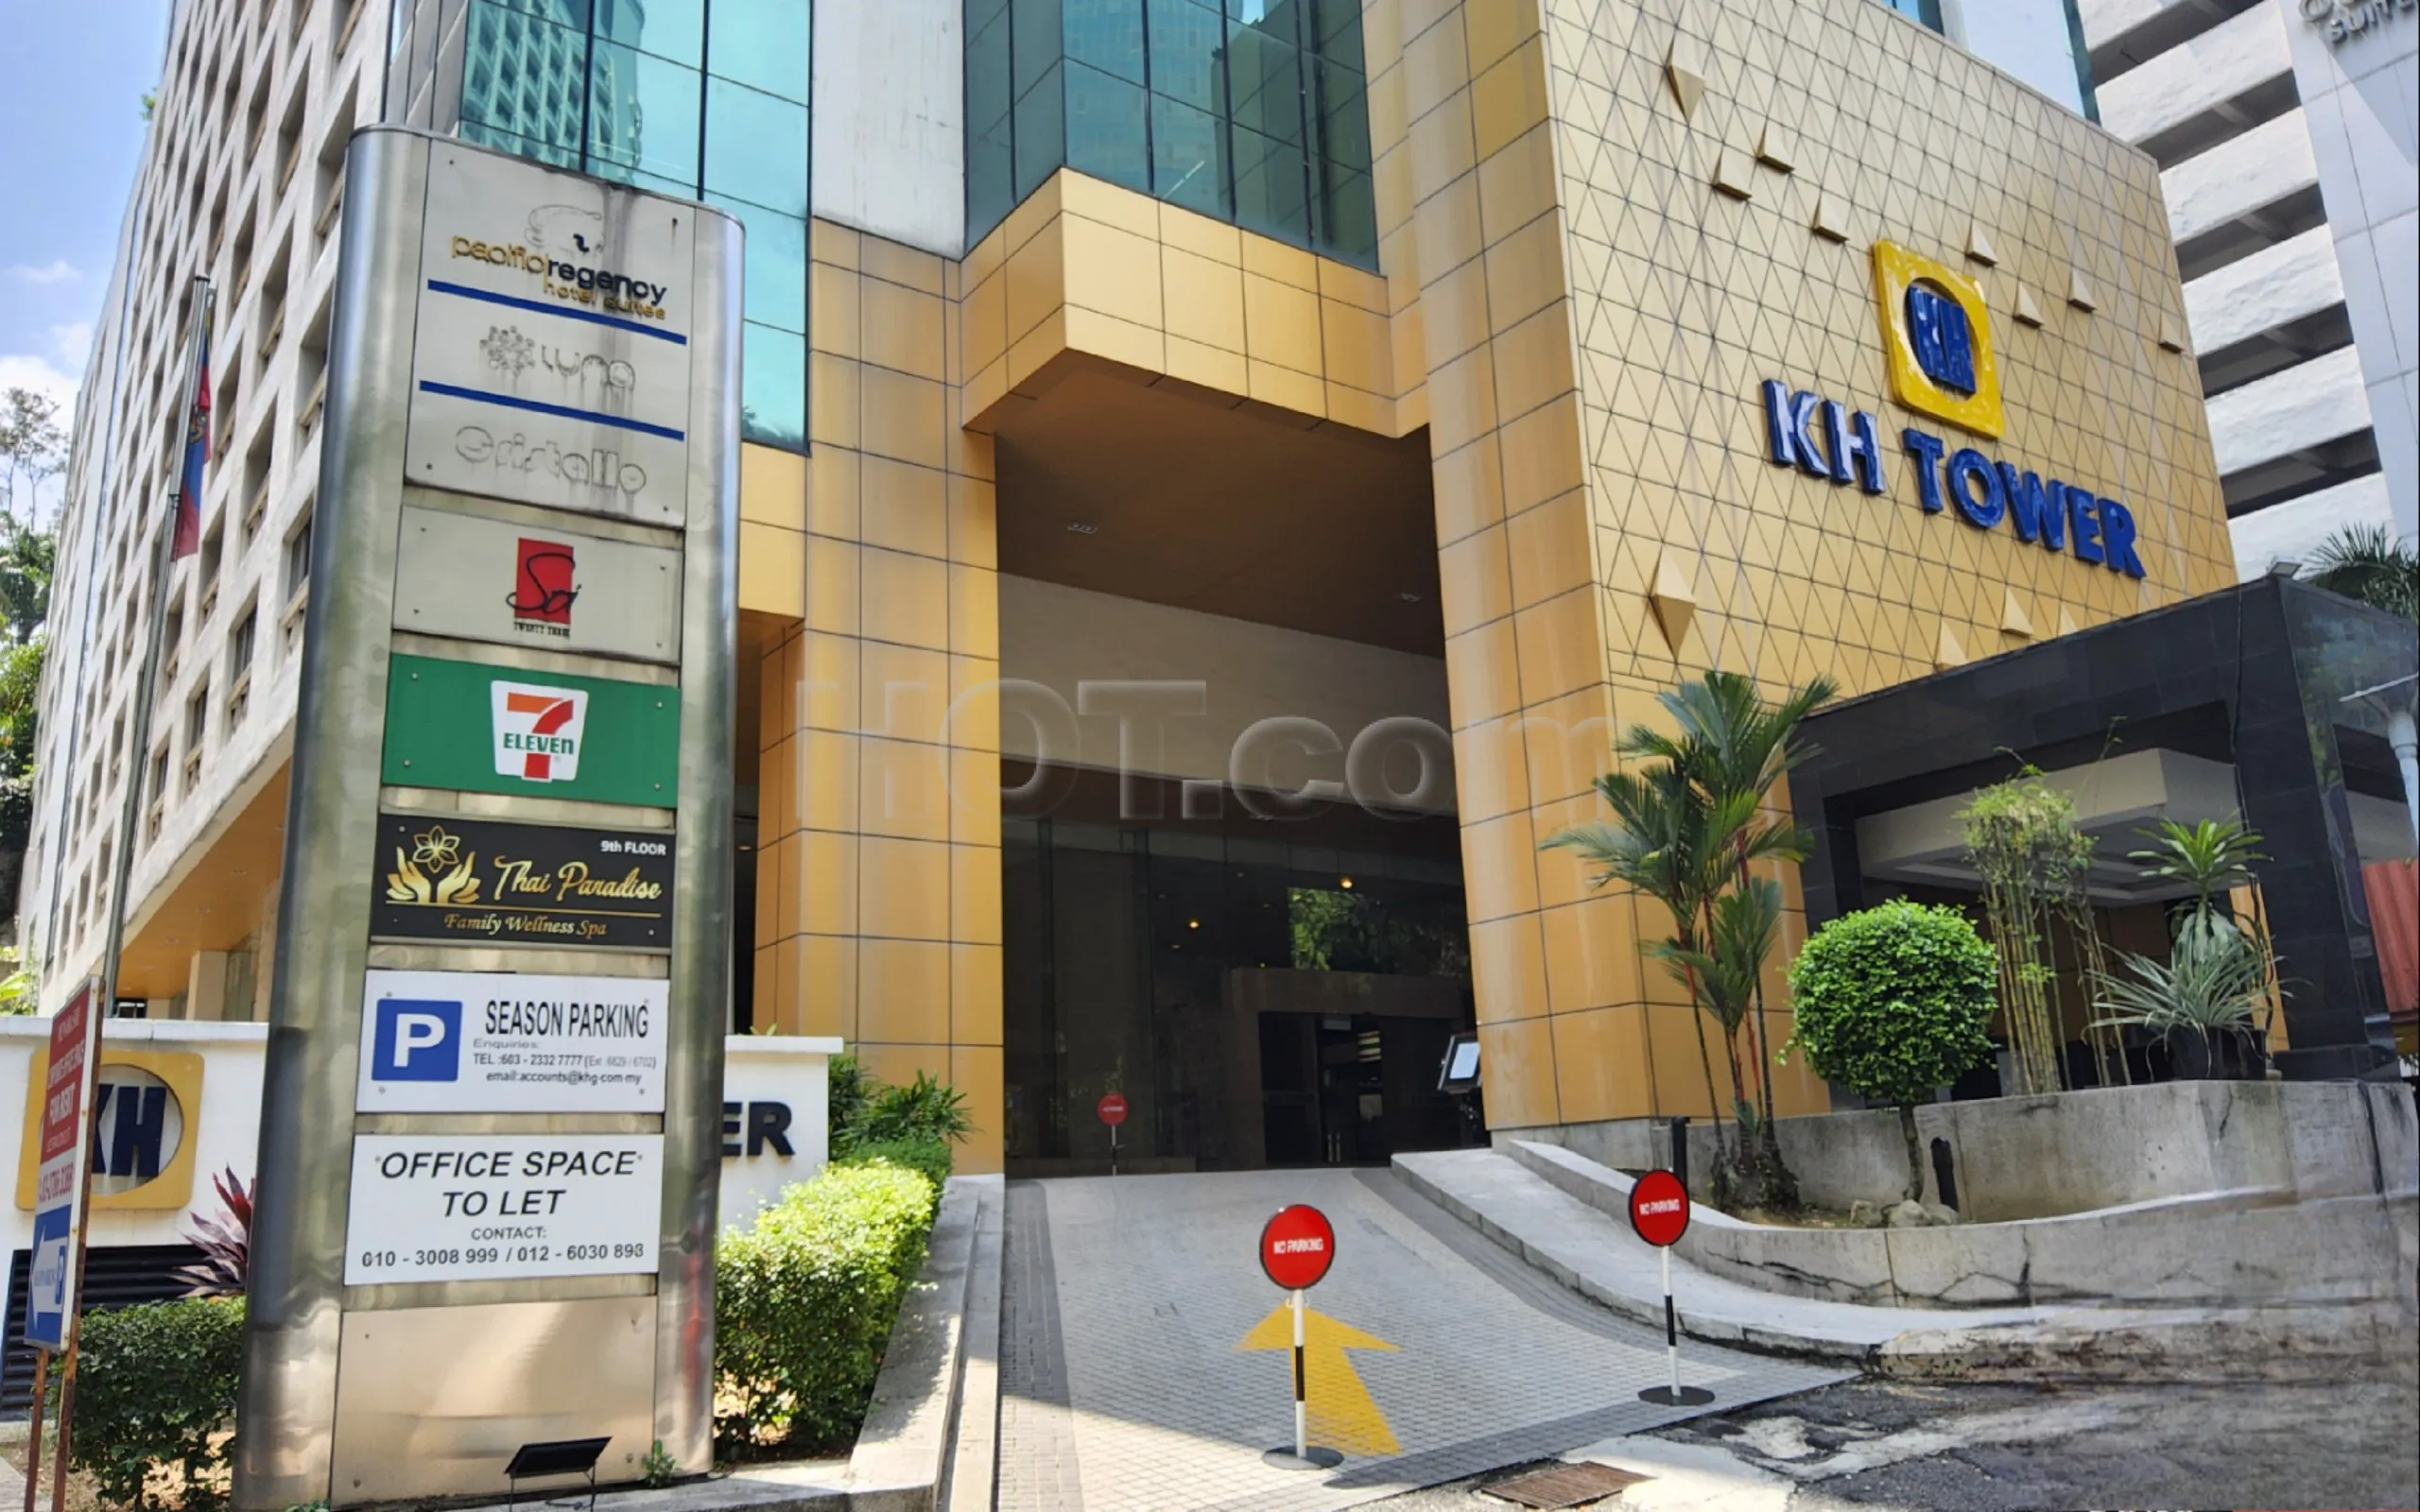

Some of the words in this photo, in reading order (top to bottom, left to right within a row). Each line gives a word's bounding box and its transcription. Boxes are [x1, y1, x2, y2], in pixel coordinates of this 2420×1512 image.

[1761, 379, 1885, 495] KH
[1902, 427, 2147, 580] TOWER
[600, 839, 621, 853] 9th
[625, 841, 666, 855] FLOOR
[494, 855, 551, 901] Thai
[557, 861, 663, 902] Paradise
[443, 913, 501, 935] Family
[505, 915, 575, 934] Wellness
[577, 919, 607, 939] Spa
[393, 1013, 445, 1068] P
[485, 1000, 562, 1037] SEASON
[569, 1003, 649, 1038] PARKING
[530, 1055, 555, 1066] 2332
[381, 1152, 513, 1178] OFFICE
[522, 1151, 636, 1177] SPACE
[442, 1191, 487, 1217] TO
[499, 1190, 566, 1215] LET
[471, 1227, 546, 1240] CONTACT:
[415, 1248, 459, 1264] 3008
[465, 1247, 498, 1263] 999
[517, 1246, 549, 1262] 012
[567, 1245, 608, 1261] 6030
